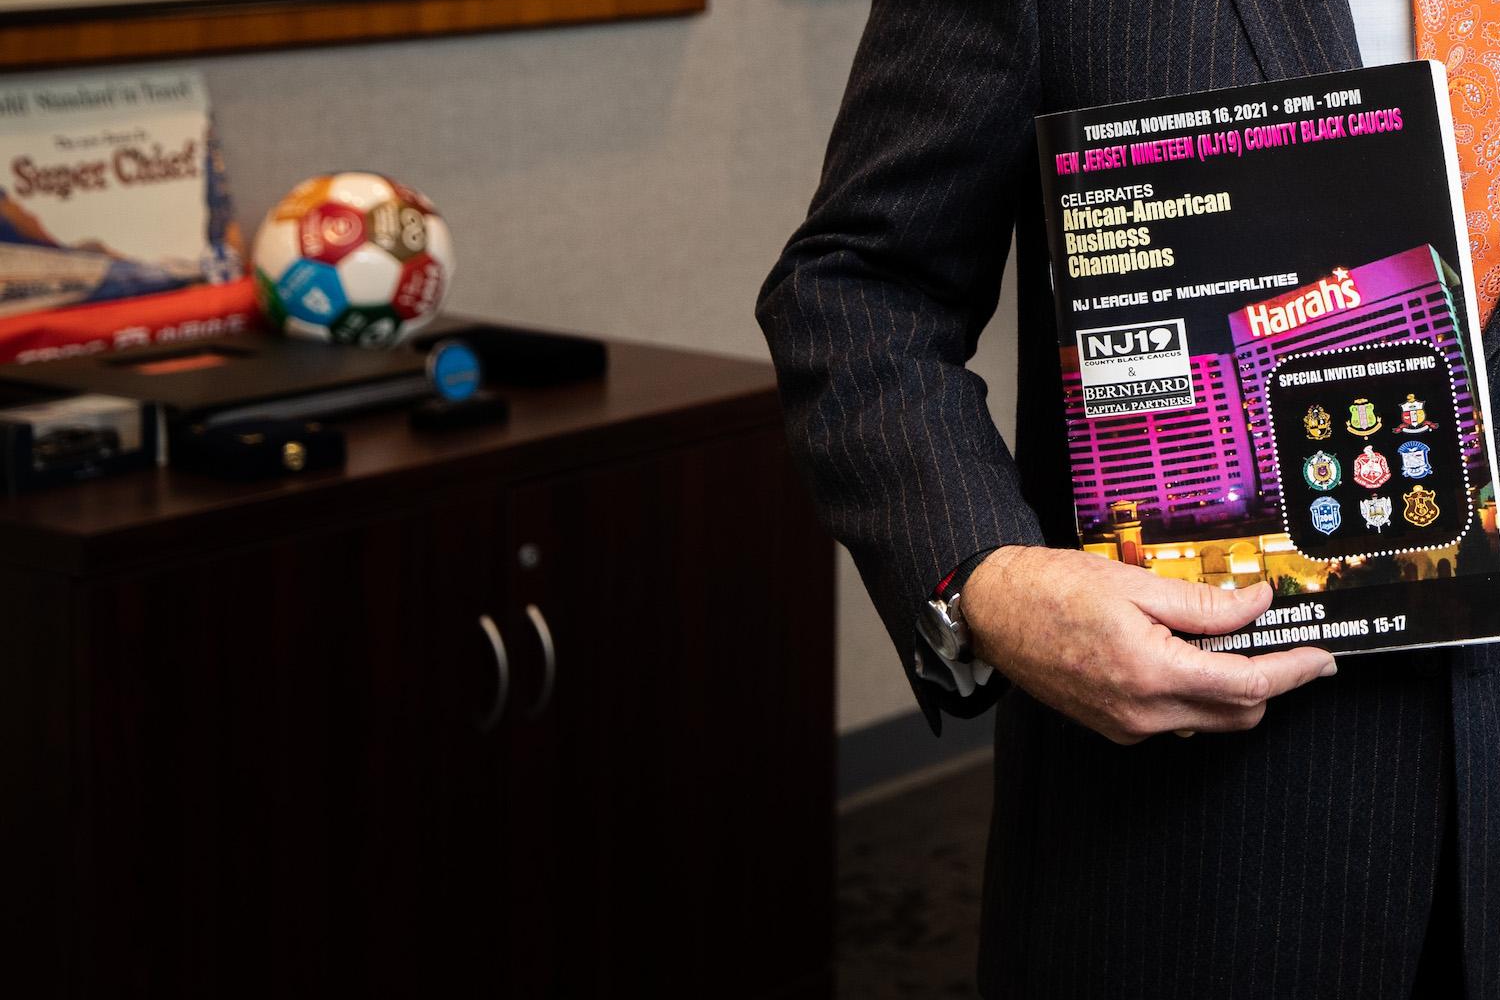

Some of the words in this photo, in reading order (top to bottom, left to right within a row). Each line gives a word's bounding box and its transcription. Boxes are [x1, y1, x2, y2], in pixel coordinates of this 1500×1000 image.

[1084, 119, 1140, 141] TUESDAY,
[1141, 109, 1212, 134] NOVEMBER
[1212, 107, 1233, 124] 16,
[1234, 102, 1267, 121] 2021
[1283, 95, 1315, 114] 8PM
[1323, 89, 1362, 109] 10PM
[1056, 152, 1080, 175] NEW
[1083, 145, 1127, 172] JERSEY
[1130, 136, 1195, 166] NINETEEN
[1197, 129, 1242, 162] (NJ19)
[1244, 122, 1297, 150] COUNTY
[1300, 115, 1347, 143] BLACK
[1348, 107, 1403, 136] CAUCUS
[11, 154, 107, 200] Super
[112, 139, 198, 189] Chief
[1061, 183, 1154, 208] CELEBRATES
[1063, 191, 1232, 232] African-American
[1065, 226, 1151, 255] Business
[1068, 247, 1175, 279] Champions
[1073, 299, 1090, 312] NJ
[1092, 292, 1149, 310] LEAGUE
[1152, 288, 1173, 303] OF
[1176, 272, 1299, 300] MUNICIPALITIES
[1088, 327, 1173, 358] NJ19
[1084, 358, 1115, 367] COUNTY
[1117, 355, 1145, 363] BLACK
[1147, 351, 1182, 360] CAUCUS
[1128, 366, 1137, 377] &
[1278, 371, 1323, 388] SPECIAL
[1323, 364, 1366, 382] INVITED
[1366, 360, 1405, 378] GUEST:
[1406, 355, 1436, 372] NPHC
[1085, 377, 1189, 400] BERNHARD
[1086, 403, 1130, 415] CAPITAL
[1131, 395, 1192, 411] PARTNERS
[1252, 624, 1321, 647] BALLROOM
[1322, 619, 1369, 639] ROOMS
[1373, 615, 1407, 633] 15-17
